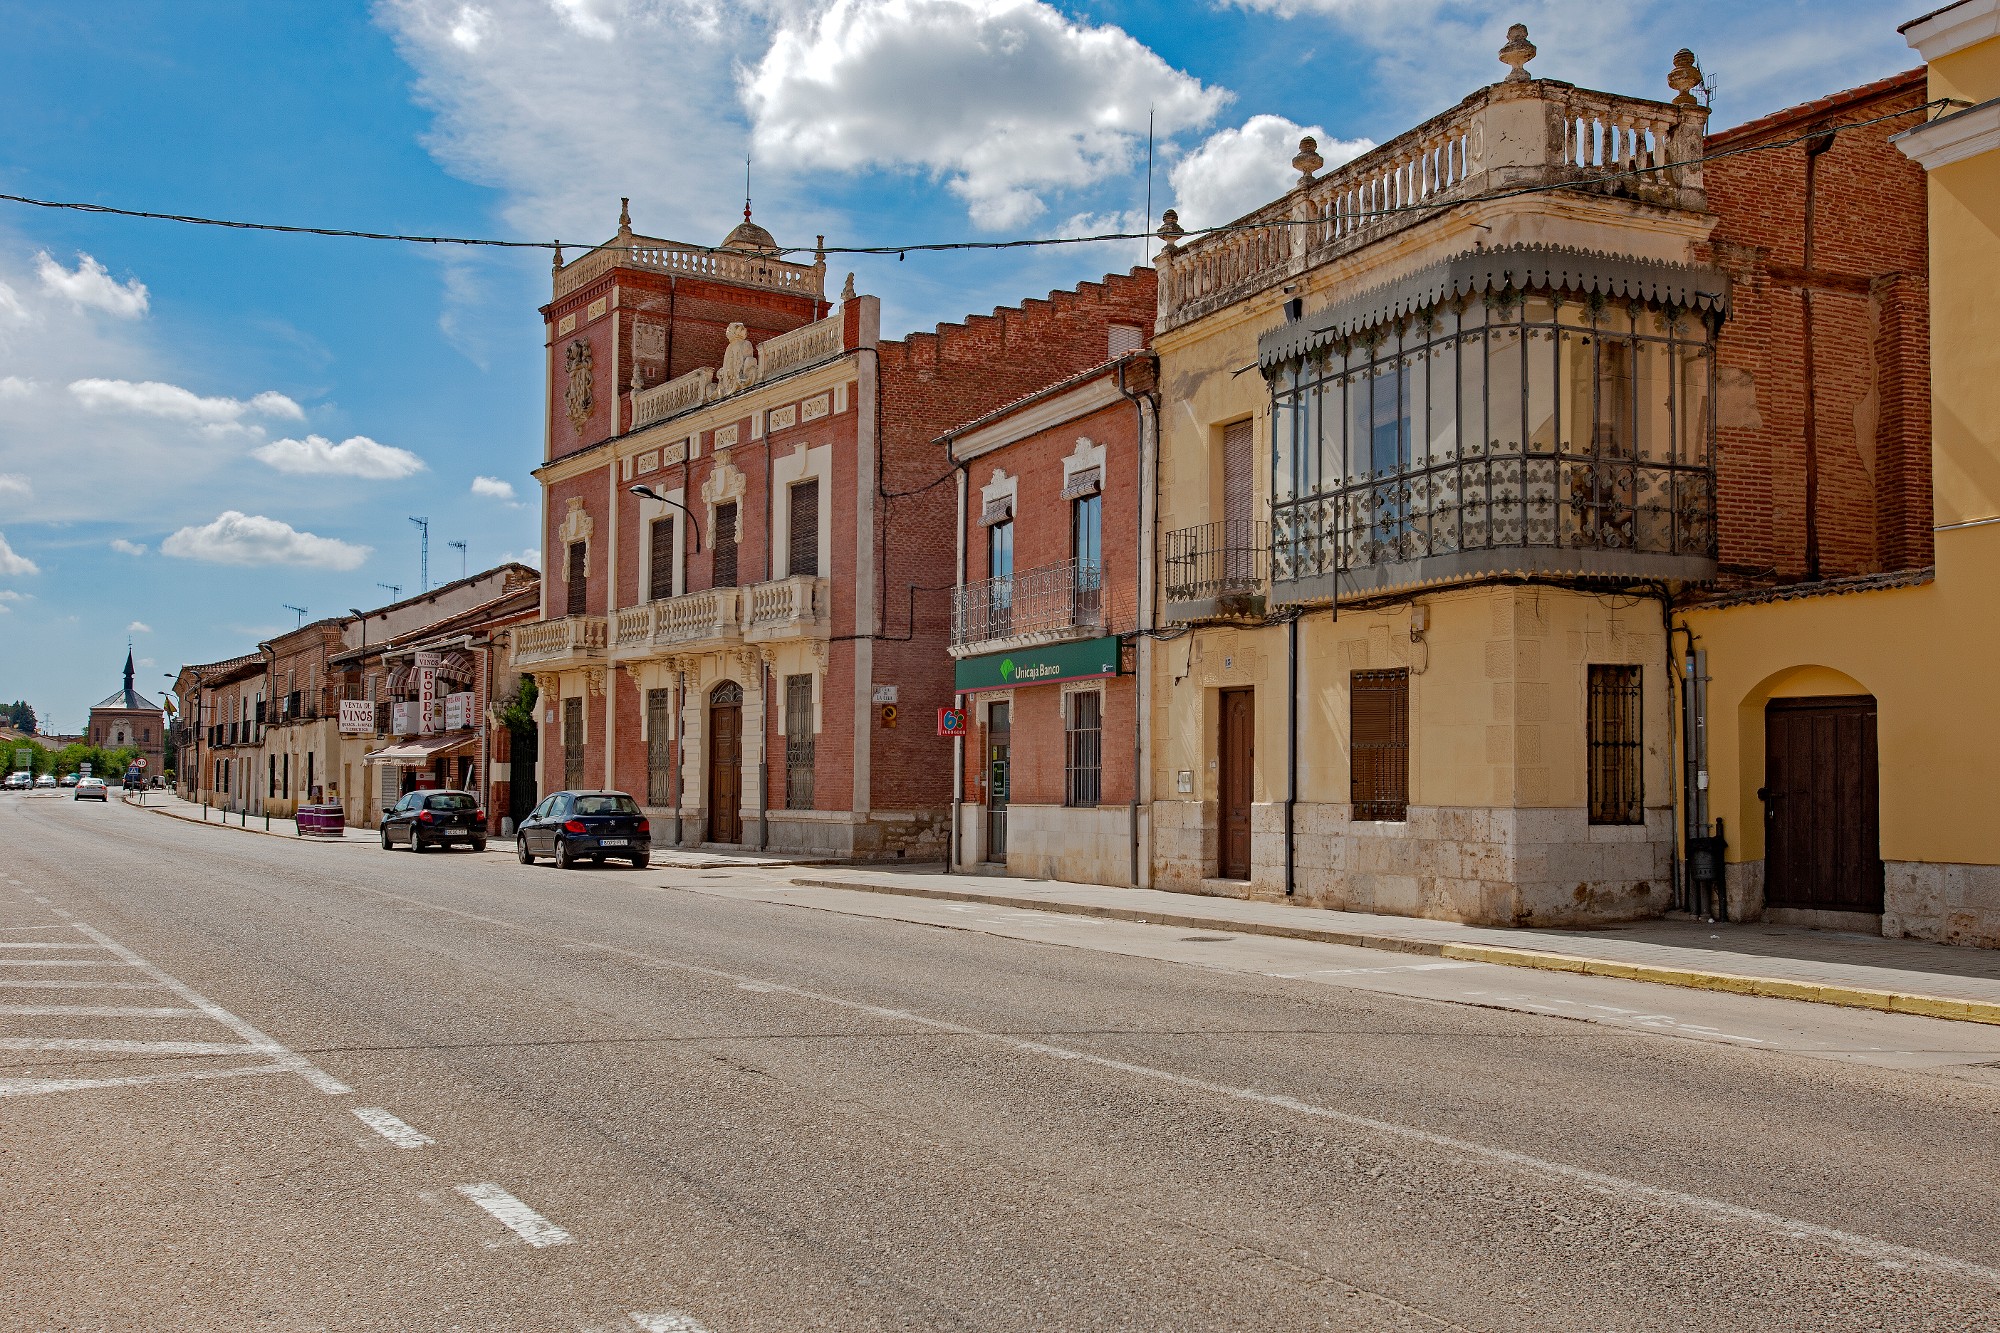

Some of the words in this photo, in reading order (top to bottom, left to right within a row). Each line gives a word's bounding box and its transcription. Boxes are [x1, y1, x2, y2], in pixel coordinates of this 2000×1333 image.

[1015, 663, 1040, 680] Unicaja
[1040, 663, 1060, 677] Banco
[344, 701, 363, 709] VENTA
[422, 670, 433, 732] BODEGA
[342, 710, 373, 722] VINOS
